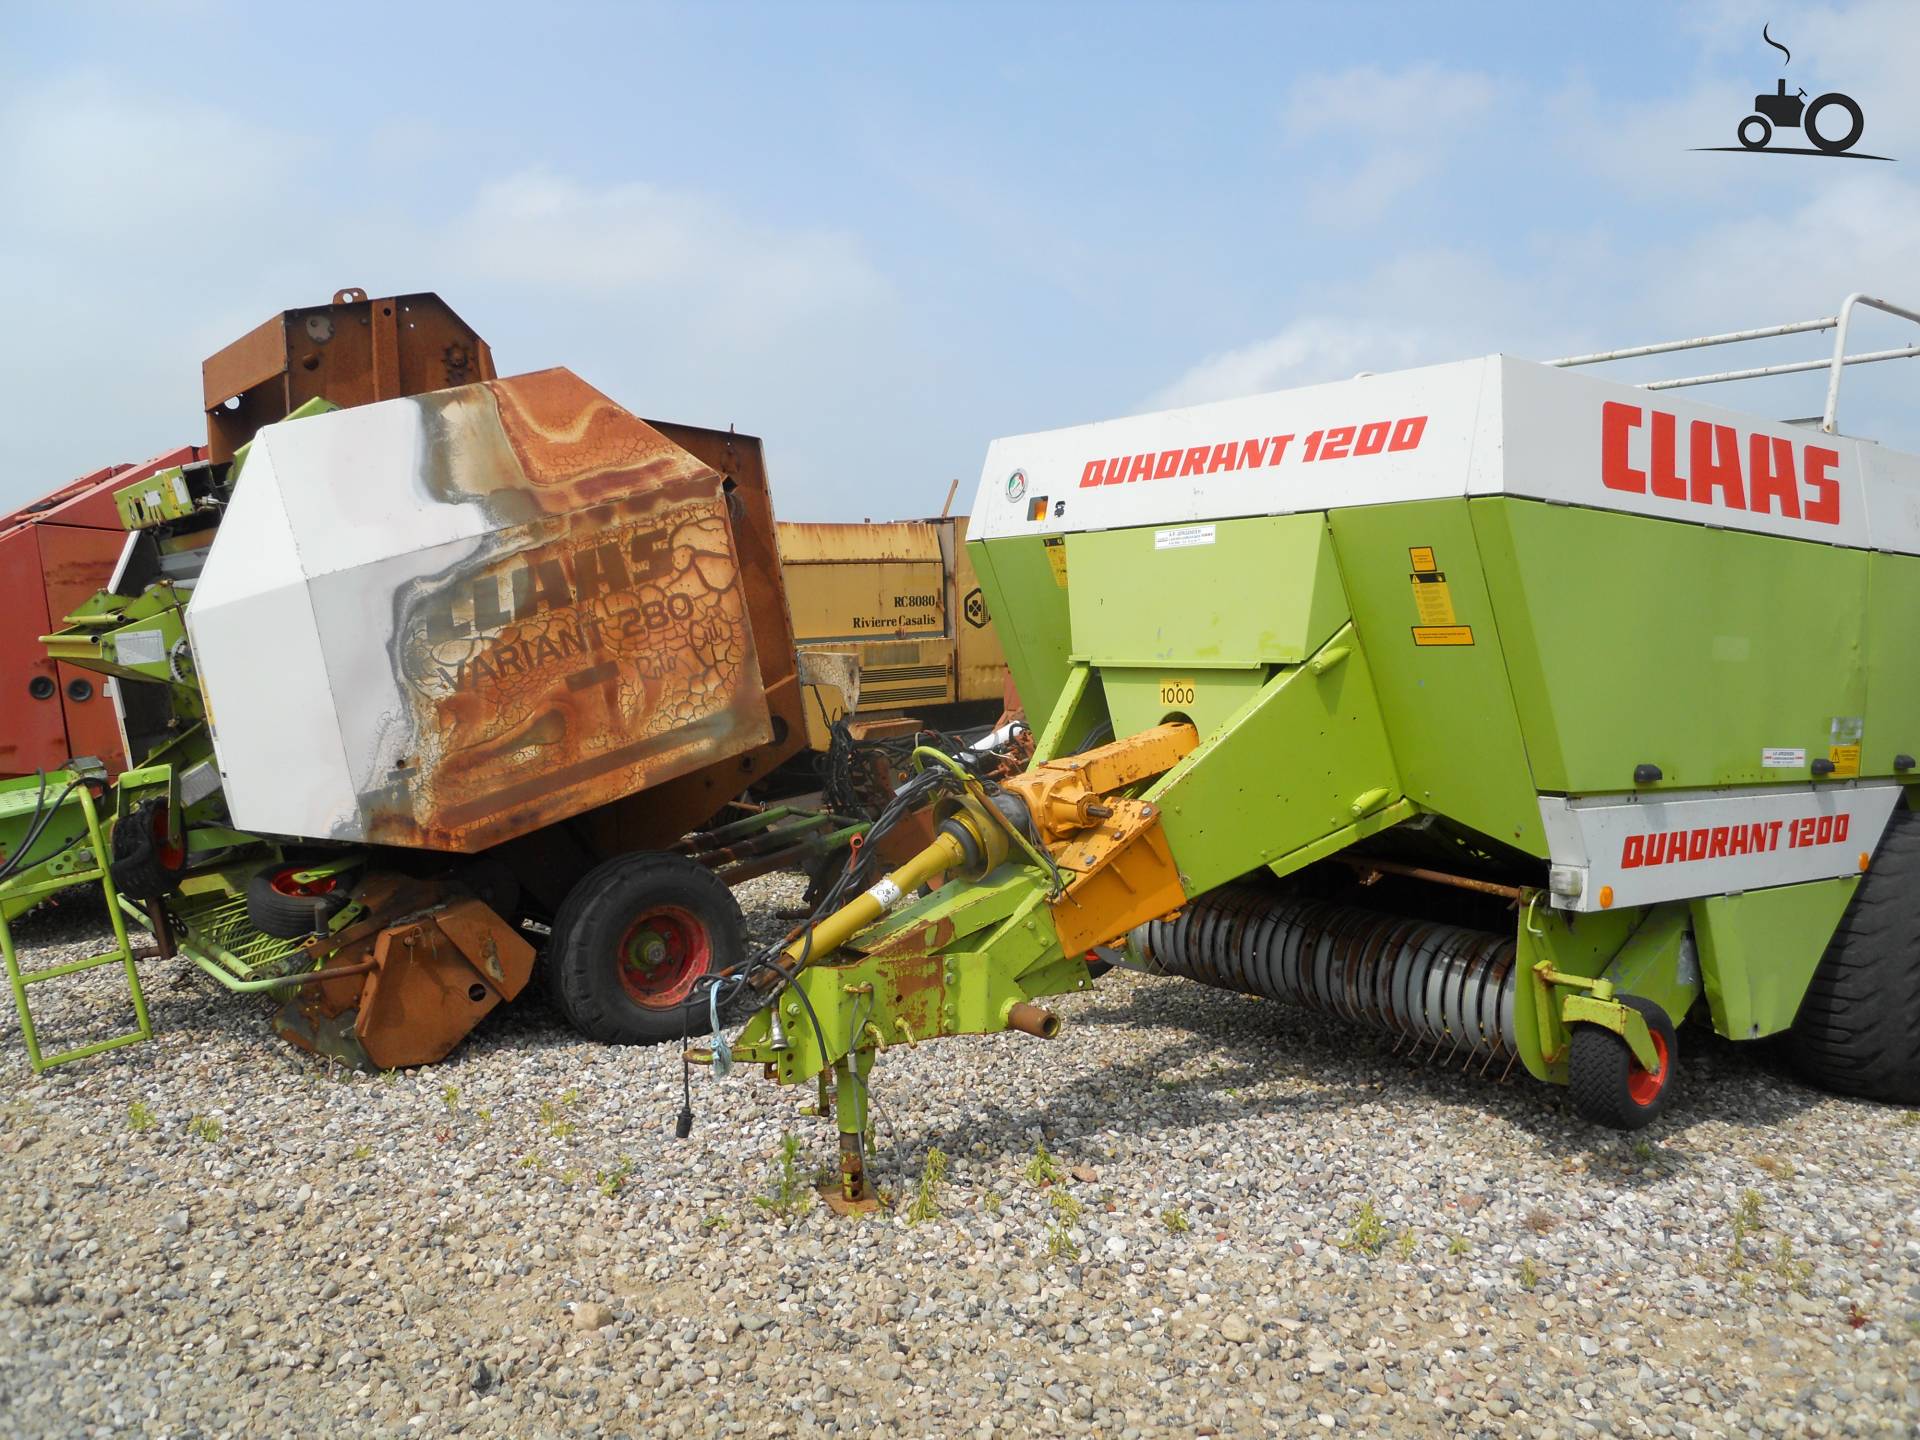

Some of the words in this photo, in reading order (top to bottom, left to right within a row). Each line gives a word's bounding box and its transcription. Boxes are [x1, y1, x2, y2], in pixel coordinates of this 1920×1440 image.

[1079, 433, 1295, 488] QUADRANT
[1302, 415, 1429, 462] 1200
[1601, 400, 1840, 526] CLAAS
[621, 592, 695, 640] 280
[853, 617, 897, 629] Rivierre
[899, 614, 936, 626] Casalis
[894, 595, 936, 608] RC8080
[1161, 688, 1194, 704] 1000
[1620, 820, 1784, 870] QUADRANT
[1788, 812, 1851, 849] 1200
